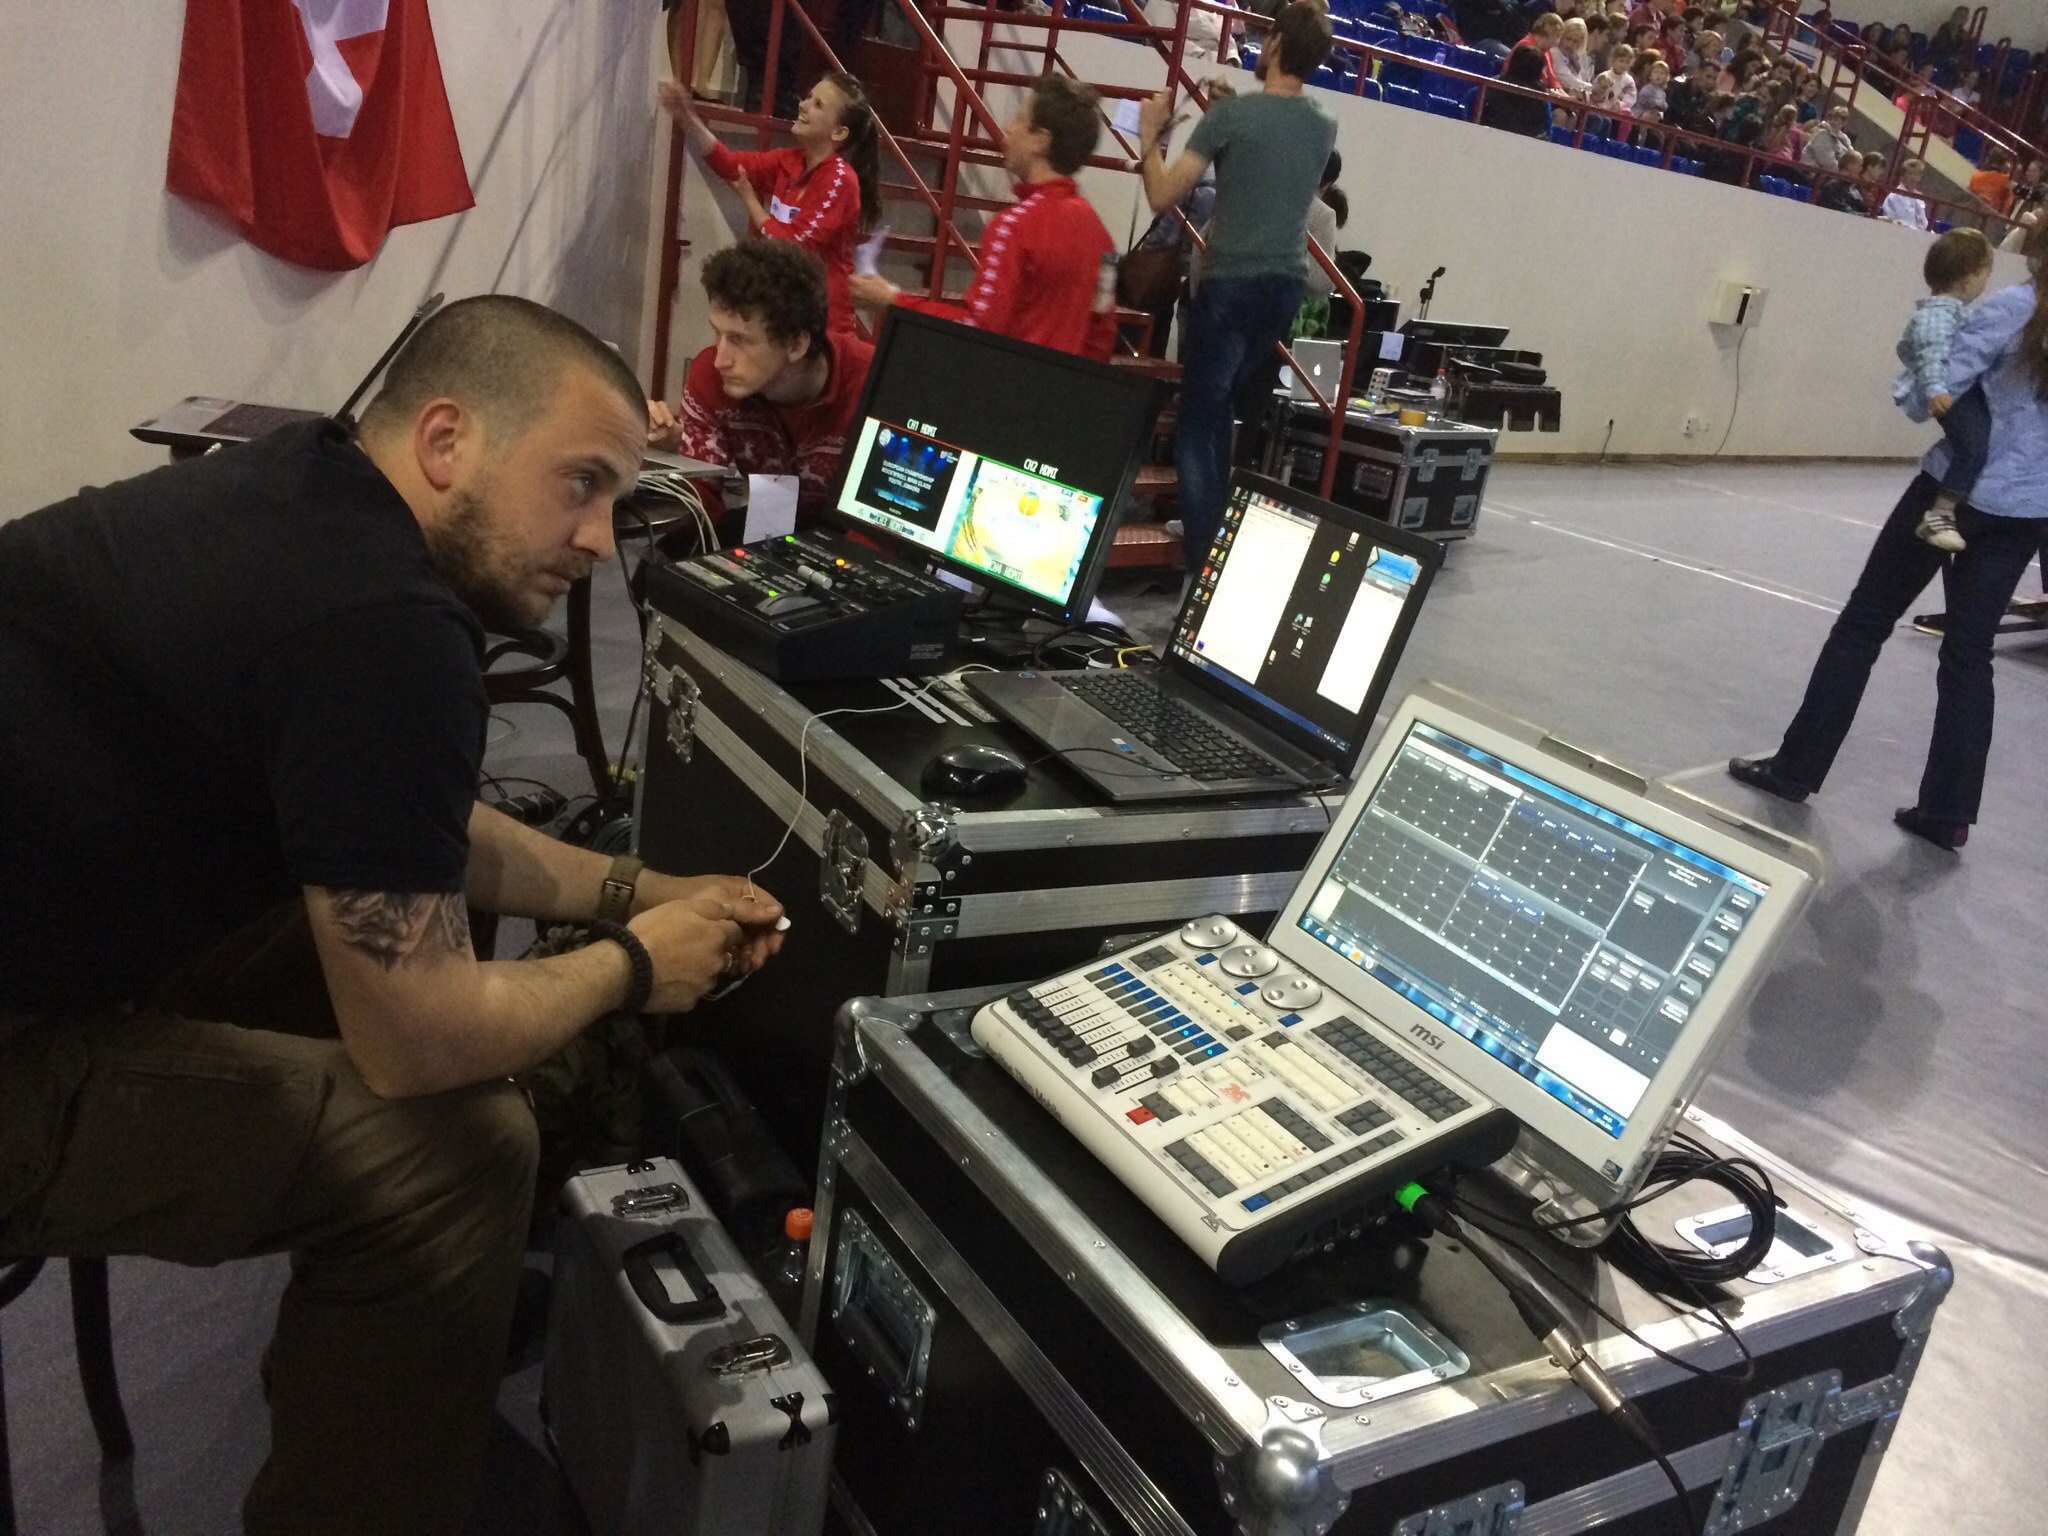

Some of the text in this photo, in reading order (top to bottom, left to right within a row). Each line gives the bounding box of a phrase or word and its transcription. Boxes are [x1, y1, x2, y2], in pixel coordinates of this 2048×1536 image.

[920, 423, 938, 438] HDMI
[1023, 458, 1059, 480] CH2 HDMI
[1410, 1023, 1446, 1050] msi
